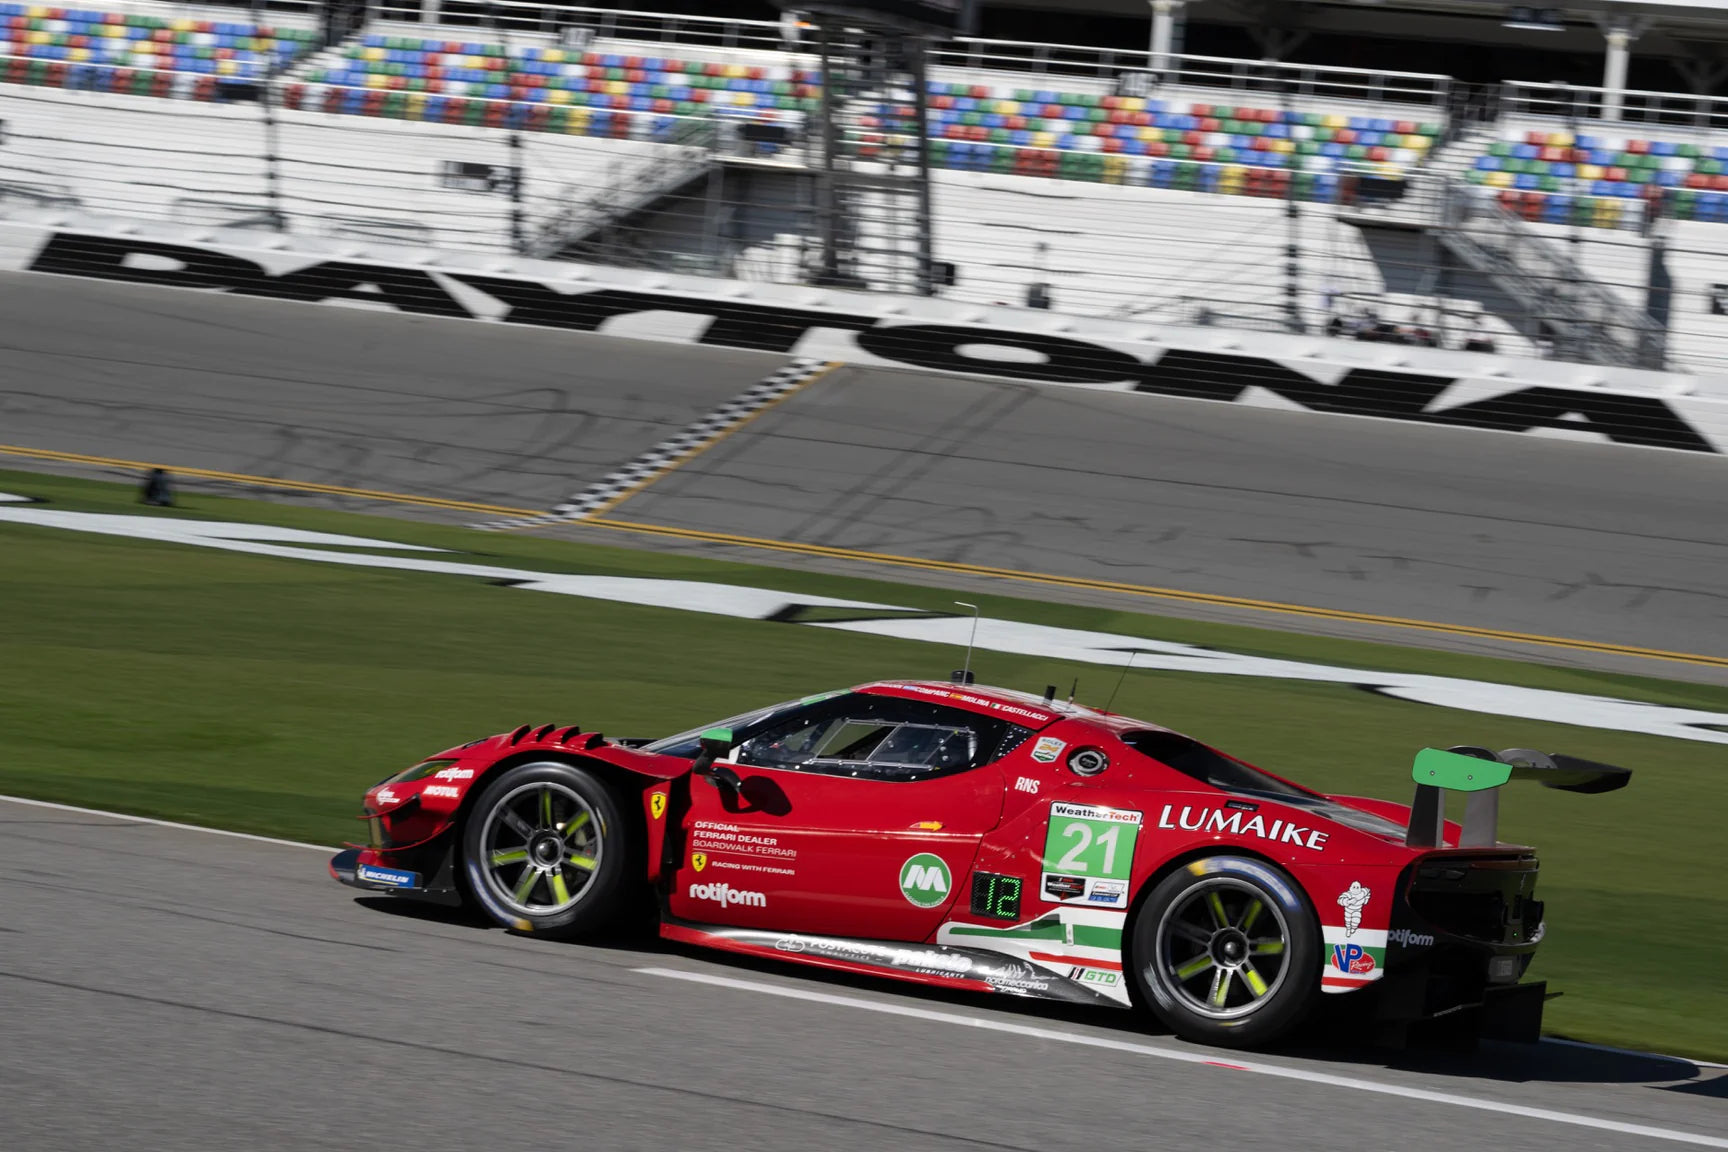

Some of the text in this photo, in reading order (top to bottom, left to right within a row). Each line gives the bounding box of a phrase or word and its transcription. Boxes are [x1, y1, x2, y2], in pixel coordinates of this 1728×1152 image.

[27, 232, 1716, 453] DAYTONA
[422, 785, 459, 798] MOTUL
[1014, 776, 1040, 794] RNS
[1055, 804, 1138, 822] WeatherTech
[694, 821, 739, 832] OFFICIAL
[1158, 804, 1330, 852] LUMAIKE
[693, 830, 777, 846] FERRARI DEALER
[692, 840, 797, 857] BOARDWALK FERRARI
[1056, 822, 1121, 874] 21
[364, 869, 410, 884] MICHELIN
[712, 861, 795, 876] RACING WITH FERRARI
[689, 882, 767, 908] rotiform
[985, 877, 1021, 917] 12
[1387, 928, 1435, 948] otiform
[1333, 943, 1364, 974] VP
[1083, 970, 1118, 984] GTD
